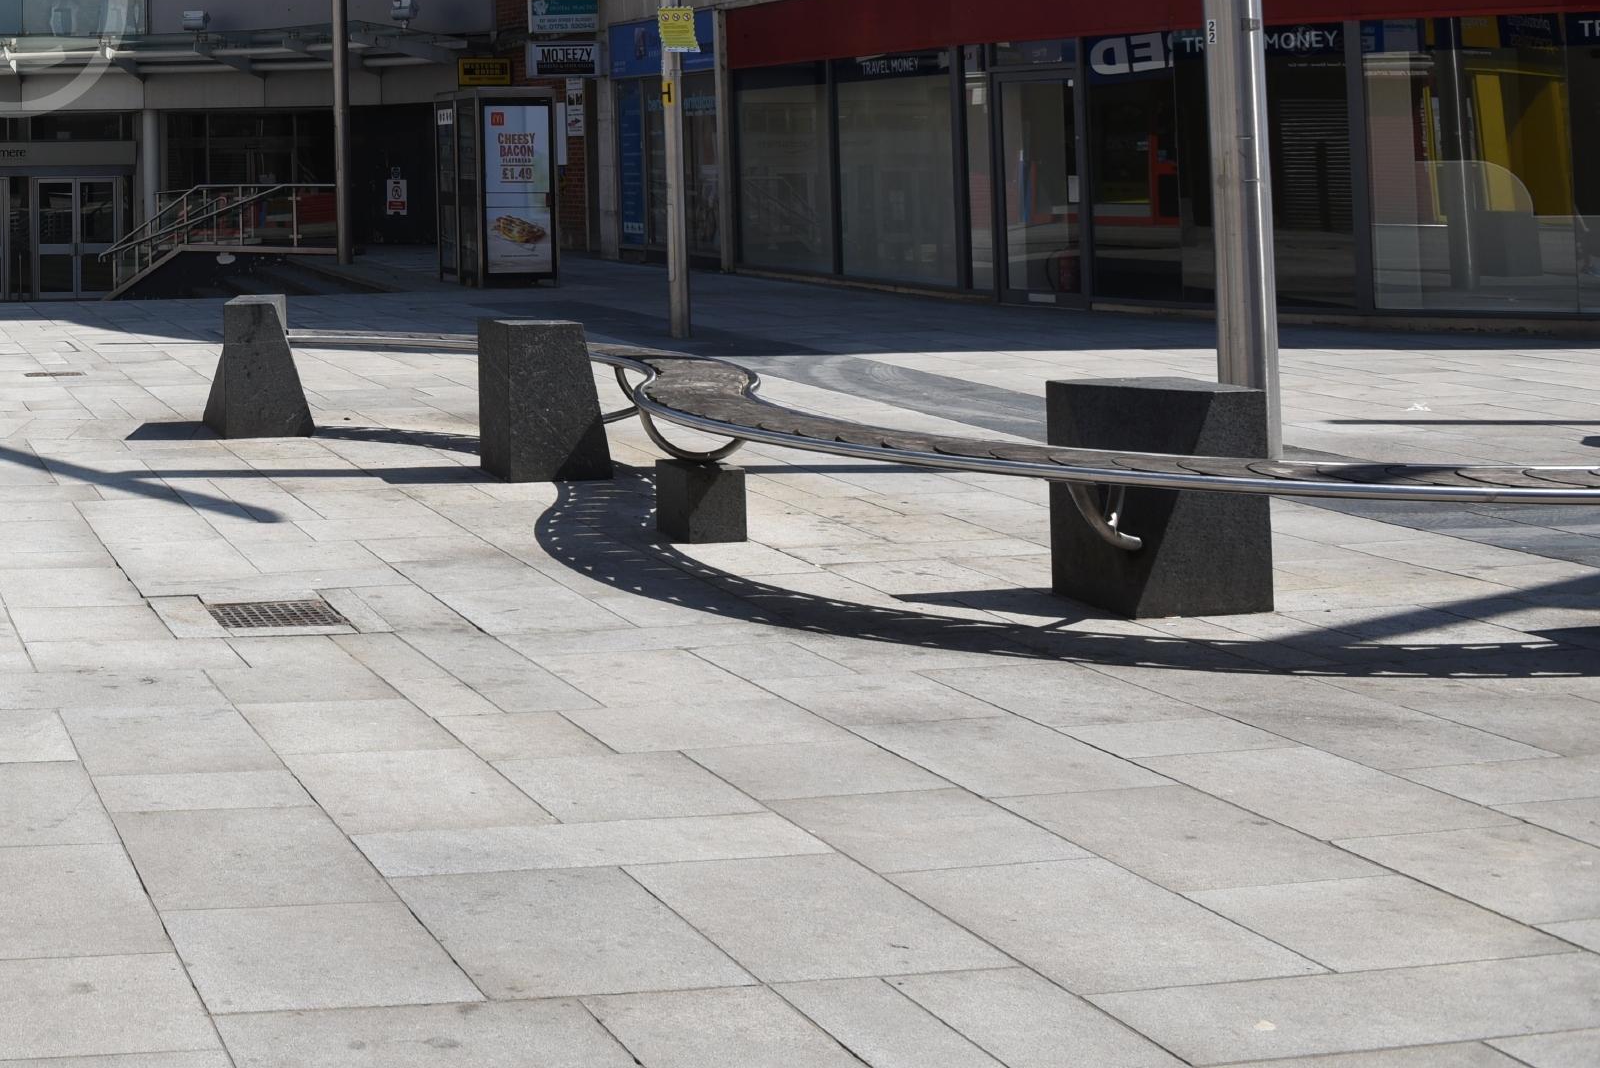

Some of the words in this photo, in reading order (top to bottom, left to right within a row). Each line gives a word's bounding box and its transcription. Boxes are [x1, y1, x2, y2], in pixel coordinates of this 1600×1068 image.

[1264, 30, 1338, 51] MONEY
[541, 48, 592, 63] MOJEEZY
[862, 59, 891, 77] TRAVEL
[891, 56, 919, 74] MONEY
[497, 132, 536, 145] CHEESY
[499, 145, 535, 157] BACON
[502, 167, 532, 180] £1.49
